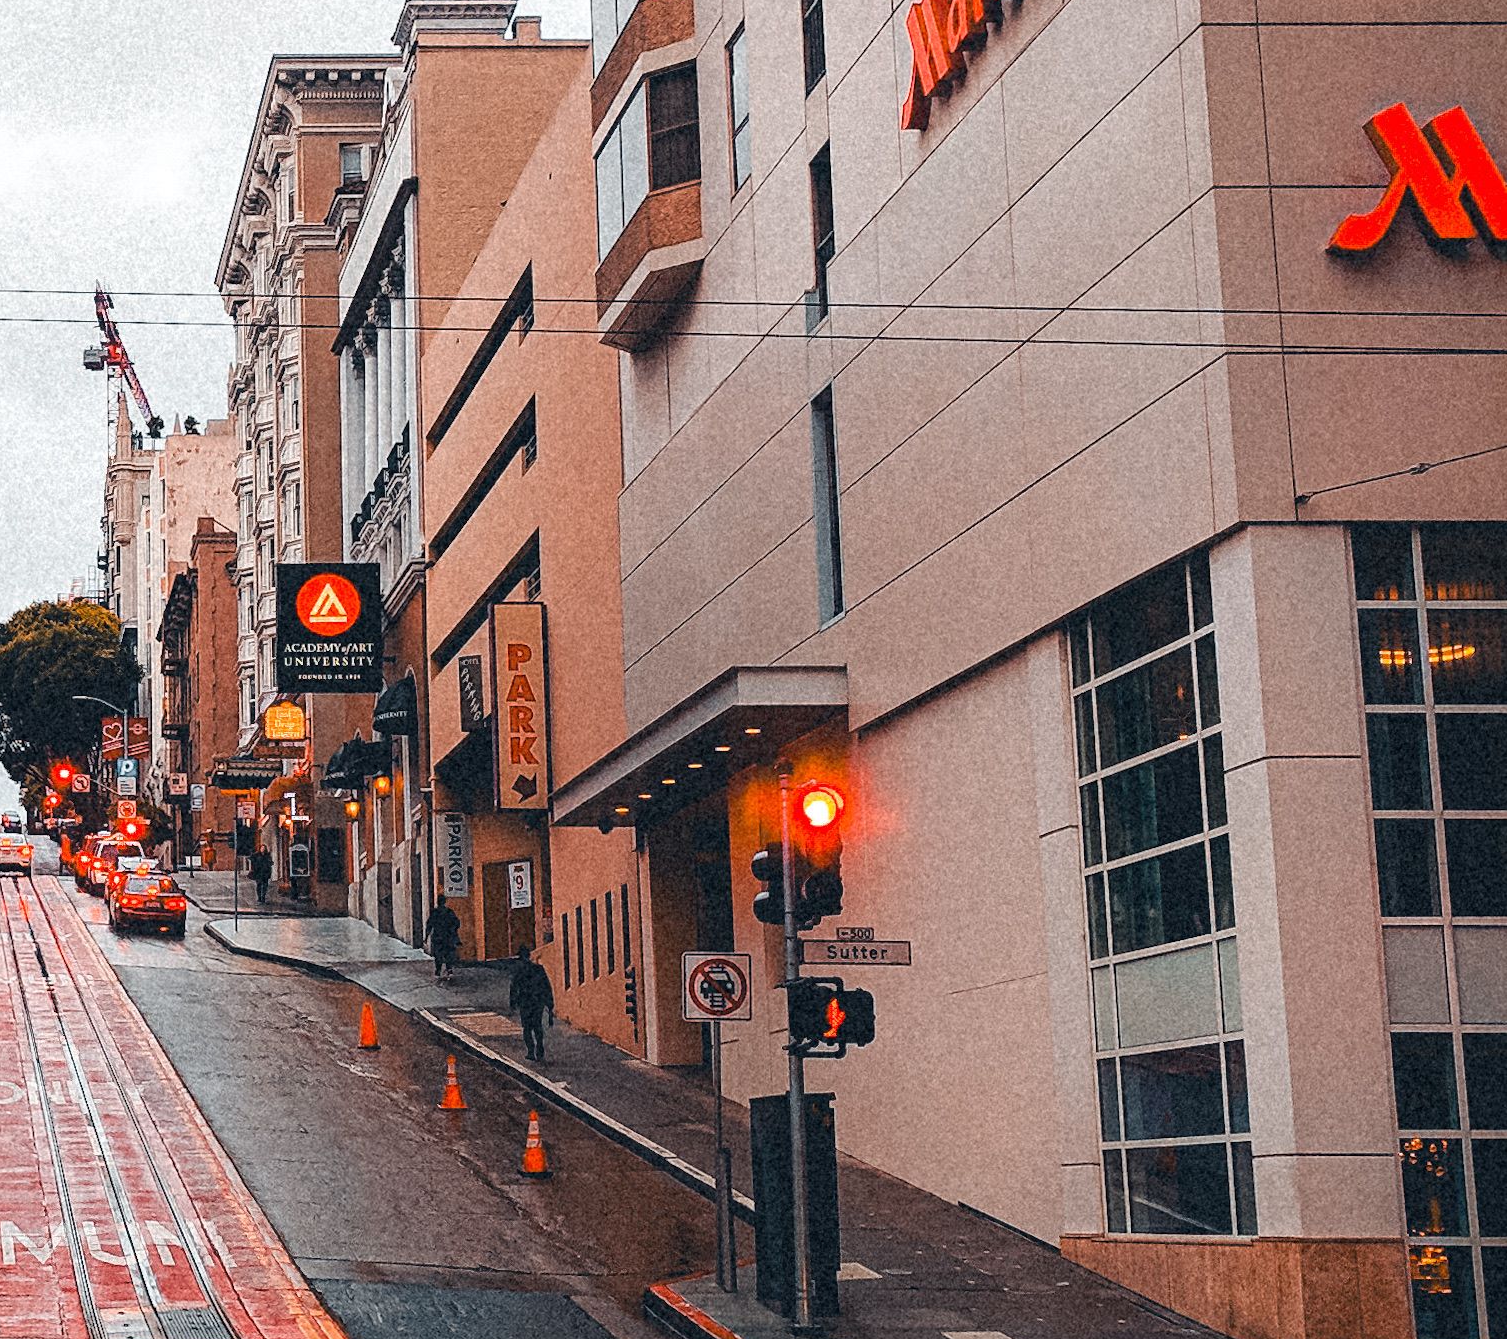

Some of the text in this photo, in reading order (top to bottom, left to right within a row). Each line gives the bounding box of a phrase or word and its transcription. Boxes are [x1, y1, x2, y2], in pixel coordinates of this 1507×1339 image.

[284, 643, 374, 655] ACADEMY of ART
[284, 656, 374, 667] UNIVERSITY
[460, 667, 482, 721] PARKING
[505, 642, 541, 765] PARK
[849, 928, 871, 940] 500
[826, 944, 889, 960] Sutter
[0, 1220, 239, 1269] MUNI
